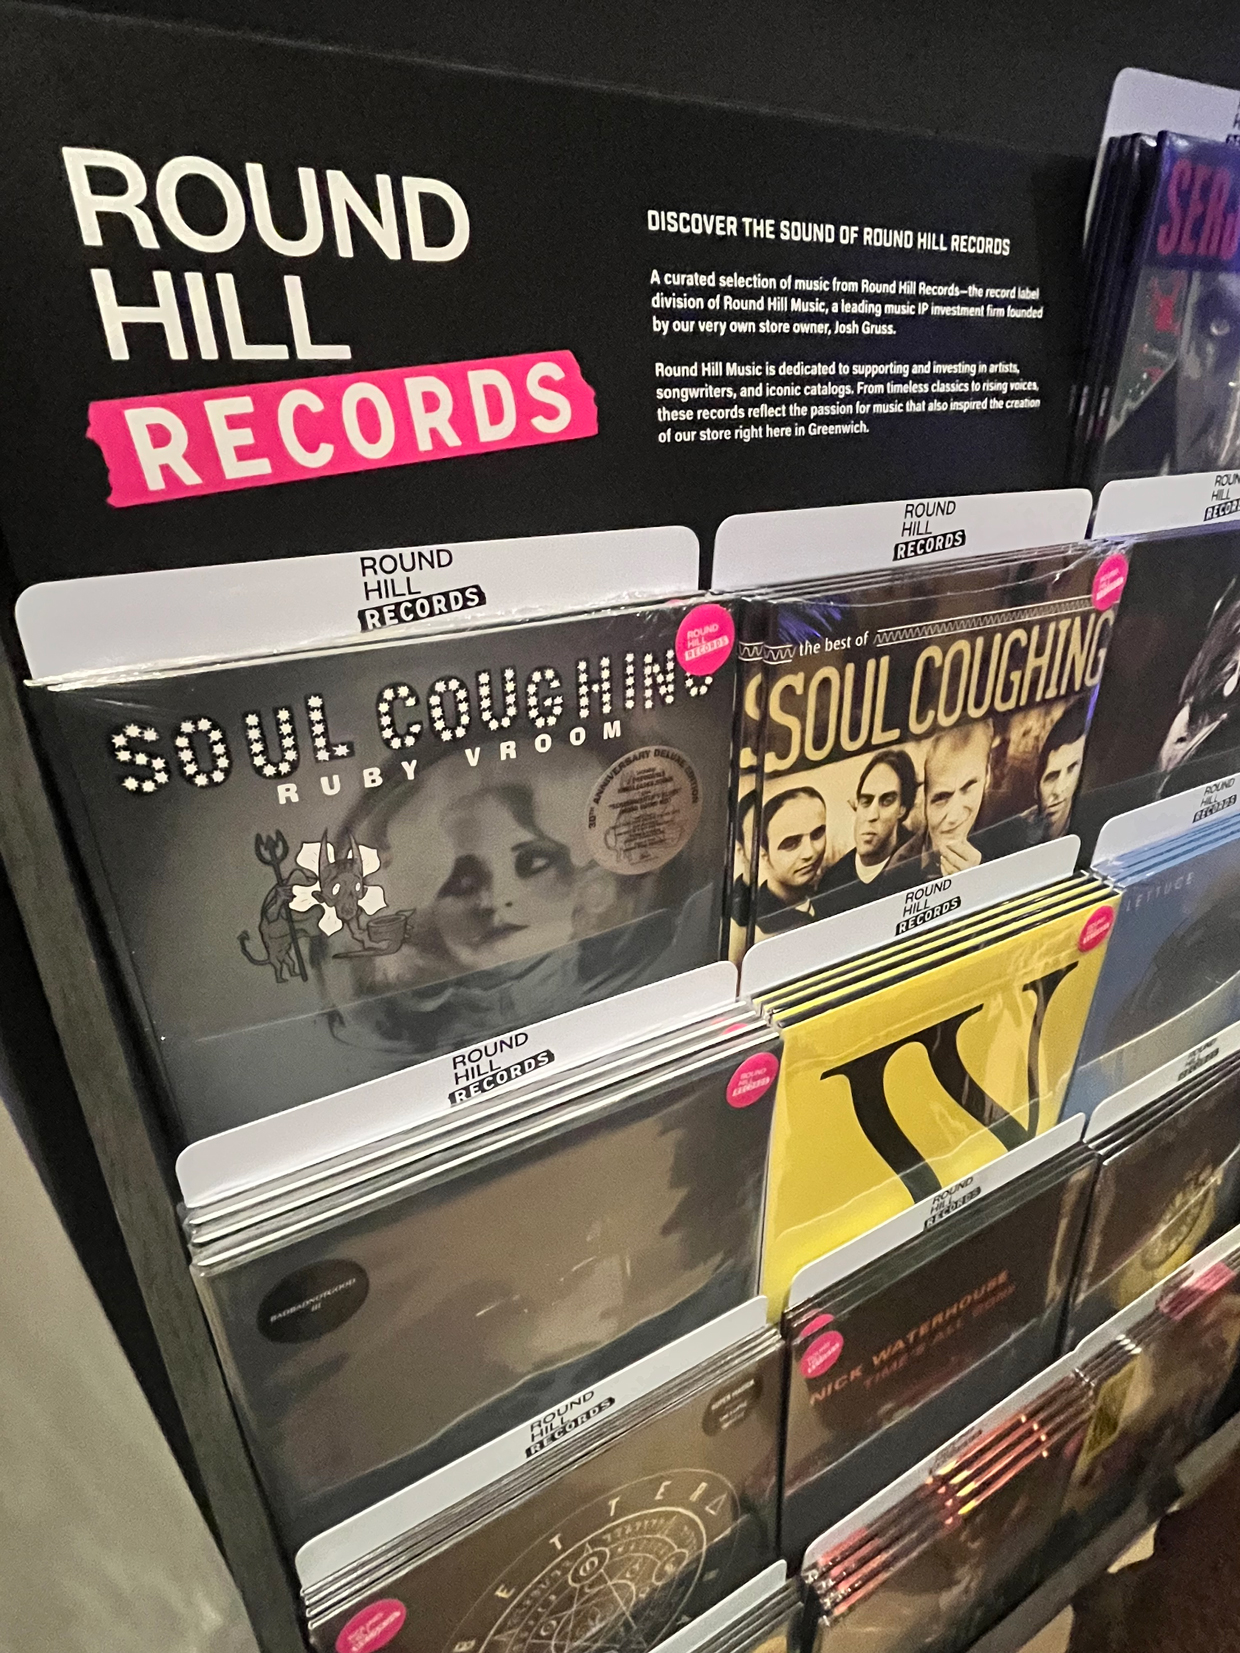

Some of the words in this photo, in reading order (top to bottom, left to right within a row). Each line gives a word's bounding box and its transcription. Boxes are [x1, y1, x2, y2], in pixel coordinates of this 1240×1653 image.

[62, 146, 470, 262] ROUND
[648, 210, 737, 236] DISCOVER
[742, 218, 775, 239] THE
[780, 221, 834, 243] SOUND
[840, 226, 858, 244] OF
[864, 227, 913, 248] ROUND
[918, 232, 947, 251] HILL
[951, 235, 1010, 256] RECORDS
[650, 269, 660, 284] A
[664, 272, 716, 287] curated
[719, 272, 776, 289] selection
[780, 275, 792, 290] of
[794, 276, 830, 291] music
[832, 277, 858, 292] from
[862, 279, 896, 294] Round
[898, 281, 916, 294] Hill
[985, 286, 1016, 299] record
[1018, 287, 1039, 300] label
[90, 268, 352, 361] HILL
[652, 292, 704, 309] division
[708, 294, 720, 310] of
[724, 295, 764, 310] Round
[768, 296, 787, 312] Hill
[791, 298, 828, 314] Music,
[832, 302, 838, 312] a
[841, 299, 882, 317] leading
[884, 301, 915, 314] music
[918, 302, 929, 314] IP
[931, 302, 984, 317] investment
[986, 304, 1005, 317] firm
[1007, 305, 1043, 318] founded
[653, 316, 669, 336] by
[672, 320, 695, 332] our
[698, 321, 726, 336] very
[730, 322, 756, 332] own
[759, 320, 790, 333] store
[793, 323, 831, 335] owner,
[834, 320, 859, 334] Josh
[862, 321, 896, 334] Gruss.
[655, 362, 698, 377] Round
[702, 362, 722, 376] Hill
[726, 362, 762, 376] Music
[766, 362, 776, 376] is
[778, 362, 836, 375] dedicated
[838, 362, 850, 375] to
[852, 361, 909, 378] supporting
[912, 361, 931, 374] and
[933, 361, 976, 376] investing
[978, 361, 987, 373] in
[989, 362, 1020, 374] artists,
[656, 384, 736, 402] songwriters,
[740, 382, 762, 397] and
[766, 382, 801, 397] iconic
[804, 382, 854, 398] catalogs.
[857, 382, 884, 394] From
[887, 380, 929, 394] timeless
[931, 380, 969, 392] classics
[971, 380, 980, 392] to
[982, 380, 1008, 394] rising
[1010, 379, 1039, 391] voices,
[657, 406, 694, 422] these
[697, 405, 745, 420] records
[748, 404, 786, 418] reflect
[789, 403, 808, 416] the
[810, 401, 853, 419] passion
[856, 401, 871, 414] for
[873, 400, 903, 413] music
[906, 400, 926, 412] that
[928, 399, 948, 411] also
[950, 398, 988, 412] inspired
[990, 398, 1004, 409] the
[1006, 398, 1040, 408] creation
[124, 361, 572, 491] RECORDS
[658, 428, 671, 443] of
[675, 431, 696, 442] our
[700, 428, 731, 440] store
[735, 425, 762, 442] right
[766, 424, 792, 437] here
[795, 423, 805, 436] in
[808, 420, 869, 435] Greenwich.
[1214, 473, 1240, 487] ROUN
[904, 500, 956, 519] ROUND
[901, 520, 932, 537] HILL
[897, 531, 963, 559] RECORDS
[360, 549, 453, 577] ROUND
[364, 576, 422, 601] HILL
[364, 587, 480, 630] RECORDS
[687, 623, 719, 640] ROUND
[799, 640, 820, 657] the
[825, 636, 852, 653] best
[855, 630, 871, 648] of
[687, 636, 727, 659] RECORDS
[764, 655, 900, 773] SOUL
[908, 610, 1115, 734] COUGHING
[110, 694, 354, 794] SOUL
[278, 760, 418, 804] RUBY
[465, 720, 622, 767] VROOM
[593, 750, 651, 805] ANNIVERSARY
[654, 748, 686, 768] DELUXE
[905, 879, 952, 904] ROUND
[898, 898, 958, 934] RECORDS
[903, 898, 930, 918] HILL
[452, 1032, 528, 1070] ROUND
[454, 1060, 502, 1085] HILL
[454, 1052, 550, 1104] RECORDS
[810, 1363, 863, 1405] NICK
[530, 1391, 594, 1432] ROUND
[530, 1398, 610, 1454] RECORDS
[531, 1416, 570, 1442] HILL
